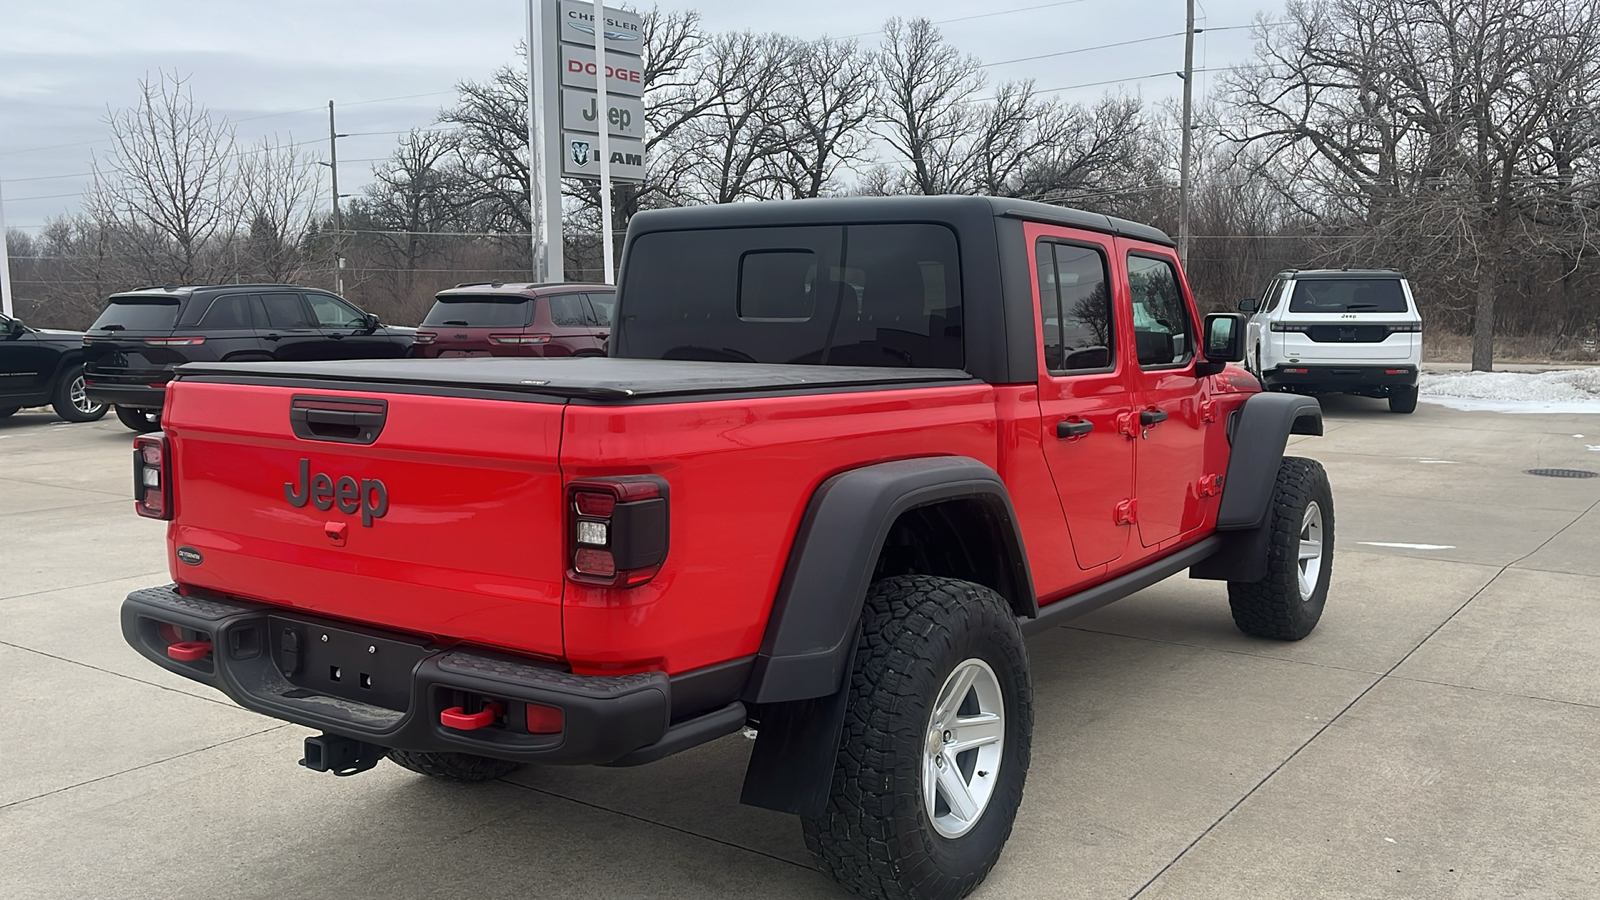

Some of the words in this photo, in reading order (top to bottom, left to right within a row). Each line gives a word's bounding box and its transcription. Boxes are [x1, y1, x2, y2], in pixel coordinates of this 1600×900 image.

[568, 10, 638, 32] CHRSLER
[582, 98, 631, 130] Jep
[284, 458, 389, 527] Jeep
